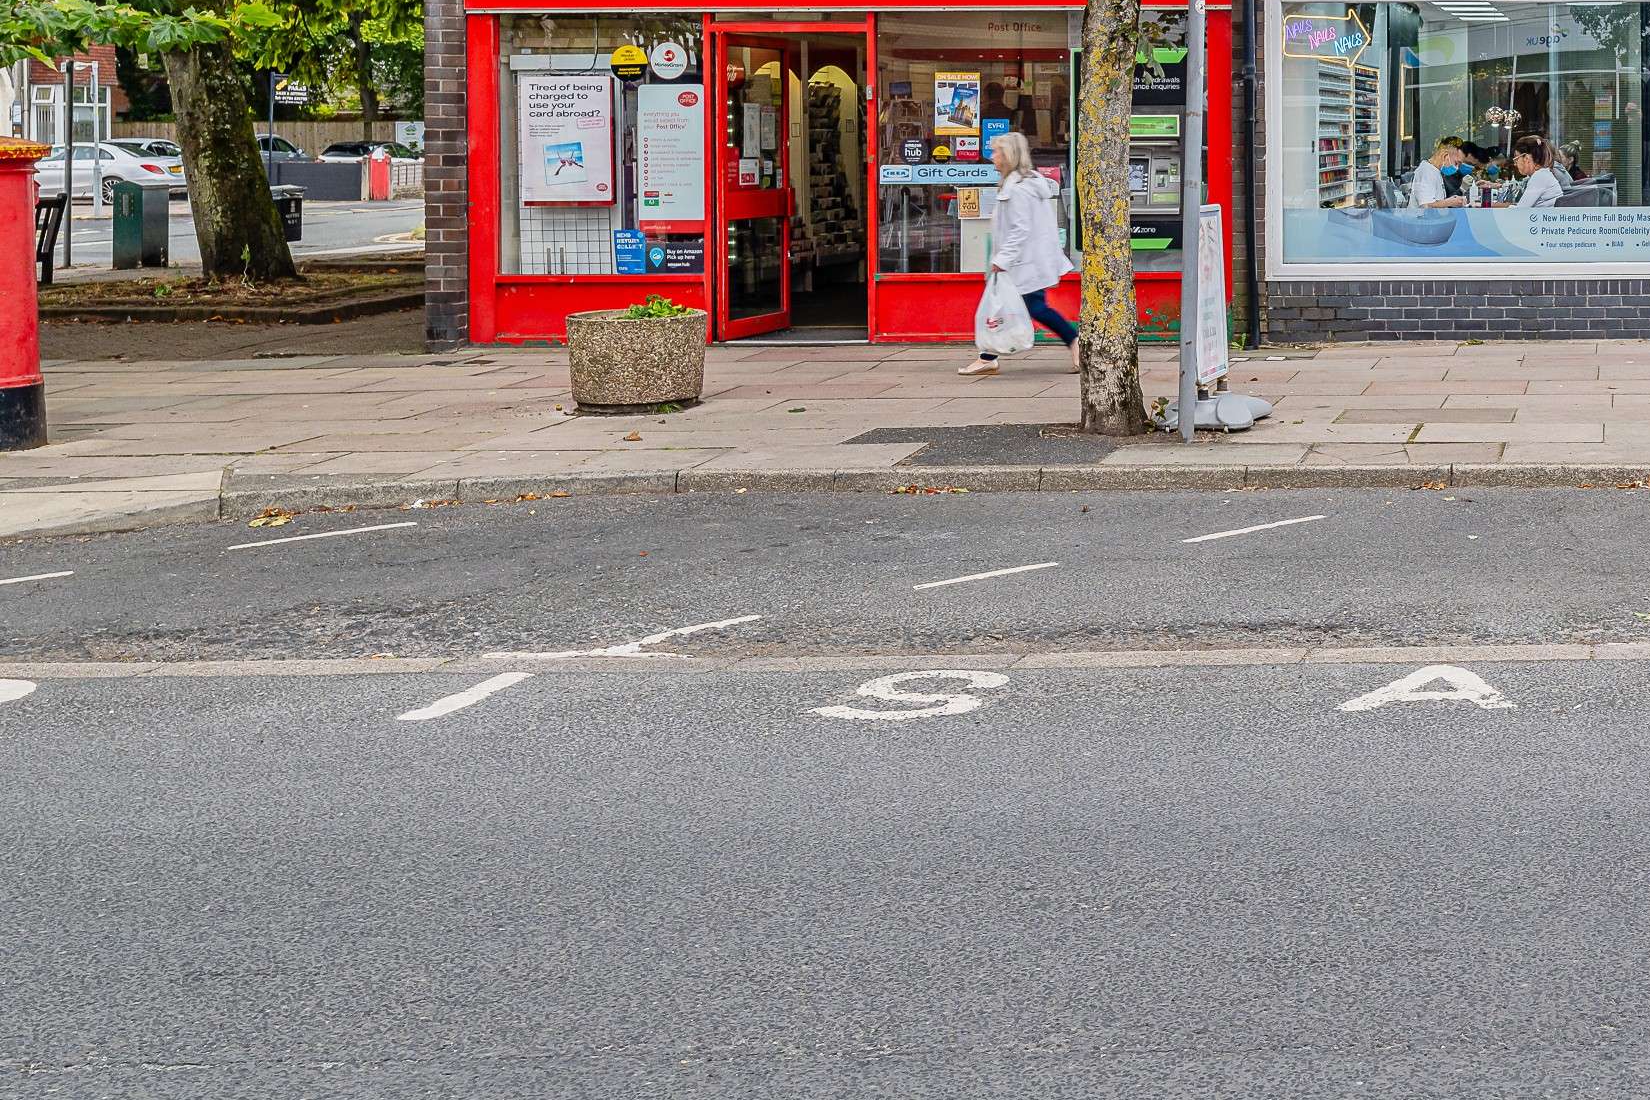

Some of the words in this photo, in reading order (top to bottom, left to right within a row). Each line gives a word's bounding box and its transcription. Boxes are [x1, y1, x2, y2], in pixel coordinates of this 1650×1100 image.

[987, 22, 1009, 32] Post
[1012, 22, 1041, 32] Office
[1286, 20, 1313, 40] NAILS
[1308, 26, 1337, 50] NAILS
[1334, 32, 1363, 56] NAILS
[528, 83, 557, 91] Tired
[559, 83, 571, 91] of
[573, 83, 603, 93] being
[528, 93, 574, 102] charged
[551, 102, 576, 111] your
[904, 148, 922, 157] hub
[917, 168, 943, 177] Gift
[946, 168, 988, 177] Cards
[1542, 214, 1557, 222] New
[1582, 214, 1601, 222] Prime
[1603, 213, 1616, 222] Full
[1618, 213, 1634, 223] Body
[1541, 227, 1565, 235] Private
[1567, 227, 1597, 235] Pedicure
